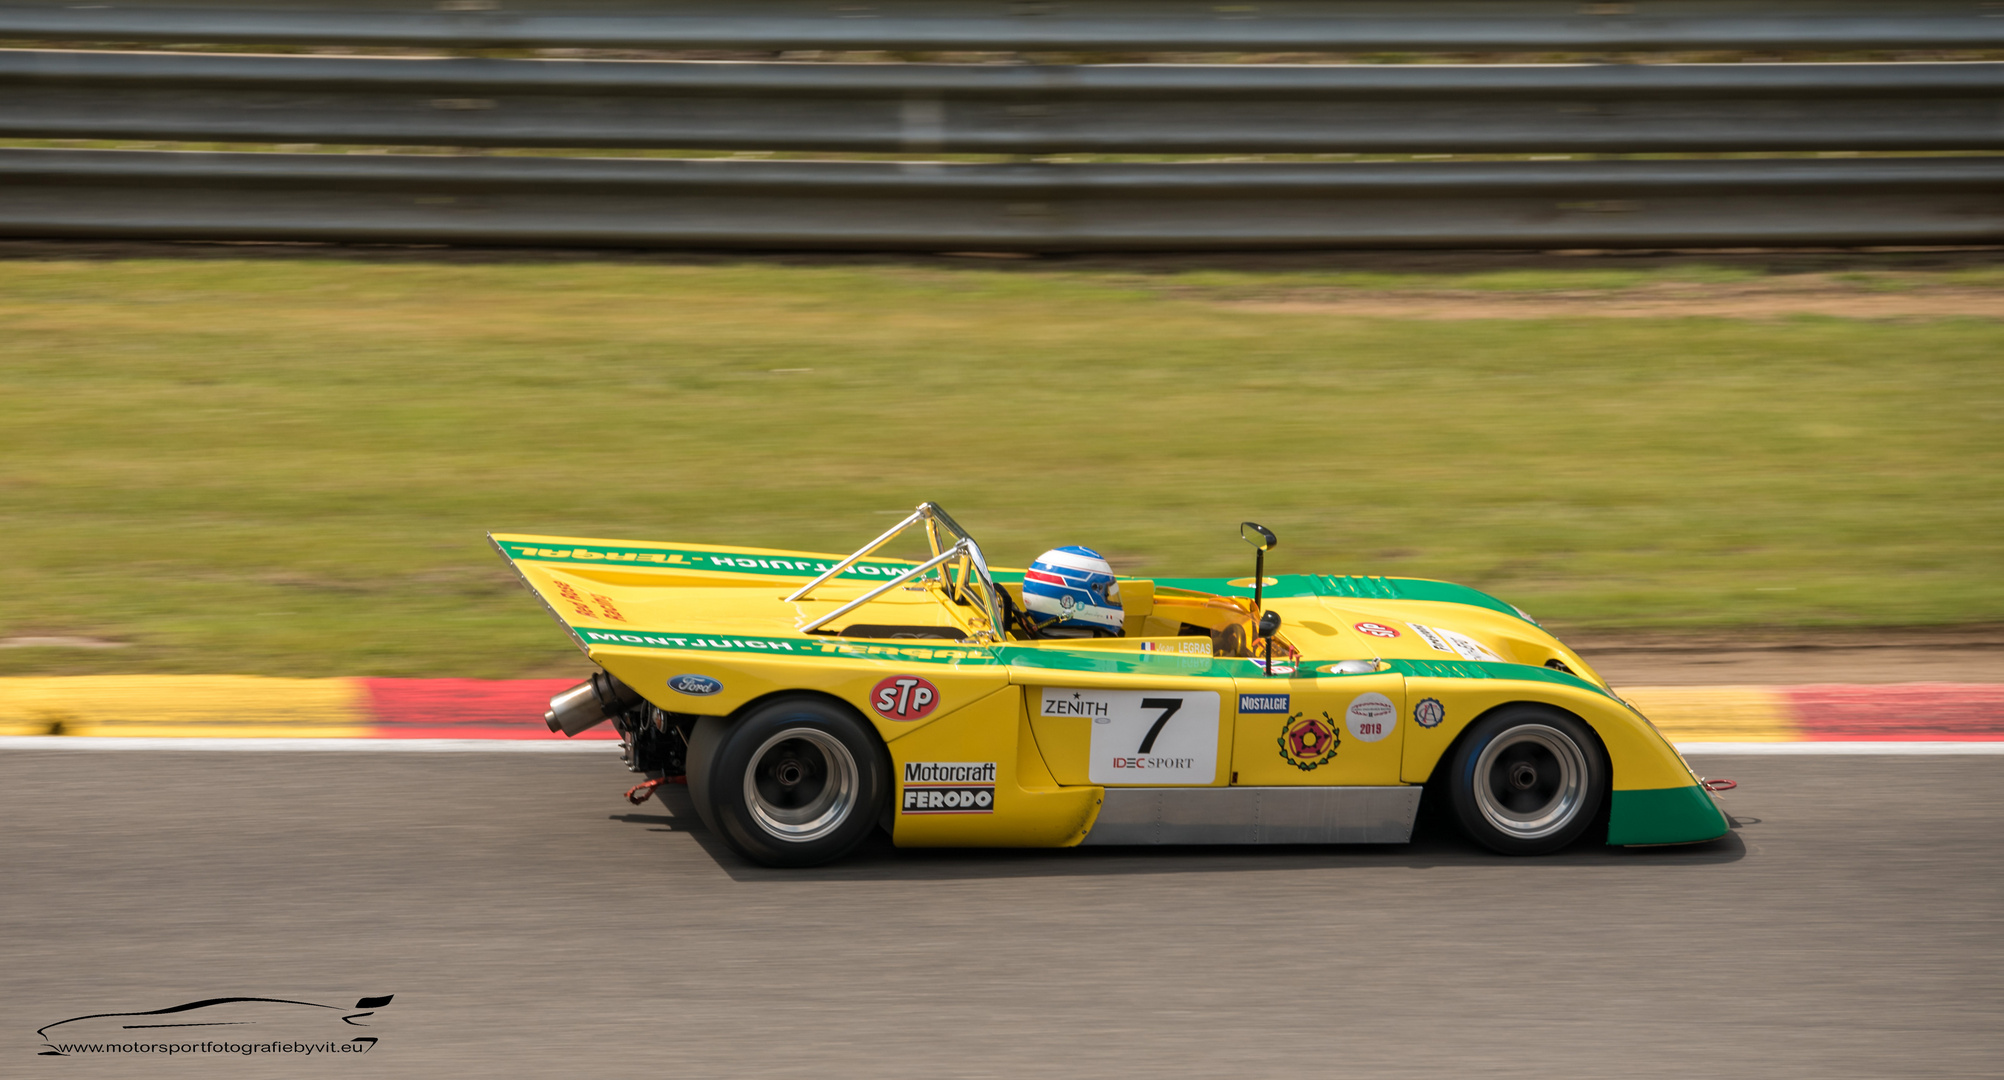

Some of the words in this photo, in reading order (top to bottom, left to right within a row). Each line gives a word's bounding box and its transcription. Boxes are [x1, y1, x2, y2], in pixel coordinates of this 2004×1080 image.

[587, 631, 794, 651] MONTJUICH
[1178, 642, 1211, 654] LEGRAS
[678, 675, 713, 693] Ford
[876, 679, 934, 716] STP
[1241, 696, 1288, 710] NOSTALGIE
[1045, 699, 1108, 716] ZENITH
[1137, 697, 1184, 754] 7
[1360, 723, 1382, 735] 2019
[1113, 757, 1145, 769] IDEC
[1147, 757, 1194, 769] SPORT
[905, 763, 995, 782] Motorcraft
[904, 790, 992, 808] FERODO
